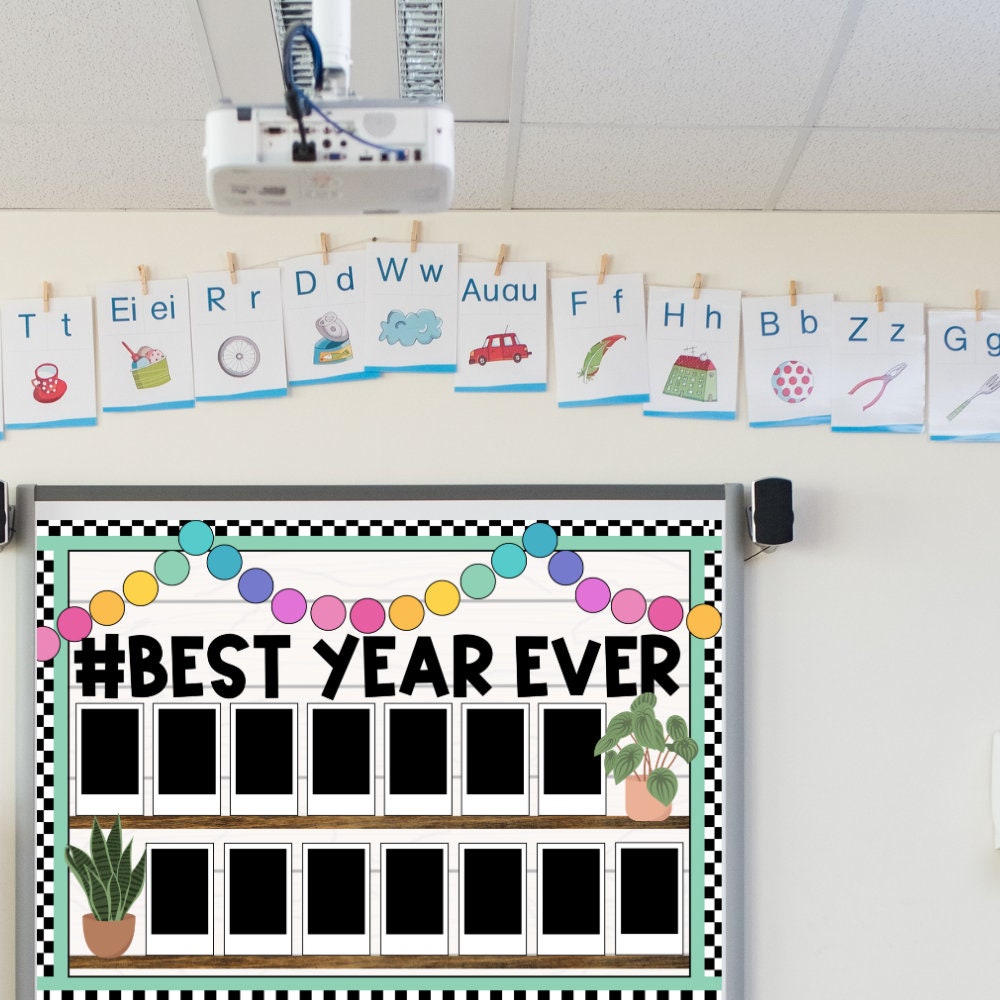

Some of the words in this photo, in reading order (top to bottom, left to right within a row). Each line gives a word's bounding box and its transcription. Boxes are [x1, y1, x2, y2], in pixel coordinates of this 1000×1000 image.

[296, 271, 316, 295] D
[337, 266, 354, 291] d
[377, 257, 408, 282] W
[420, 264, 443, 282] w
[112, 297, 136, 322] Ei
[151, 295, 175, 320] ei
[208, 287, 226, 311] R
[251, 291, 260, 309] r
[572, 291, 587, 316] F
[613, 289, 623, 313] f
[18, 314, 36, 338] T
[61, 314, 71, 336] t
[664, 302, 684, 327] H
[706, 304, 721, 329] h
[761, 312, 779, 336] B
[801, 310, 817, 334] b
[849, 317, 868, 341] Z
[891, 324, 904, 342] z
[944, 326, 966, 351] G
[986, 333, 1000, 357] g
[74, 634, 291, 699] #BEST
[312, 634, 493, 700] YEAR
[515, 634, 681, 698] EVER
